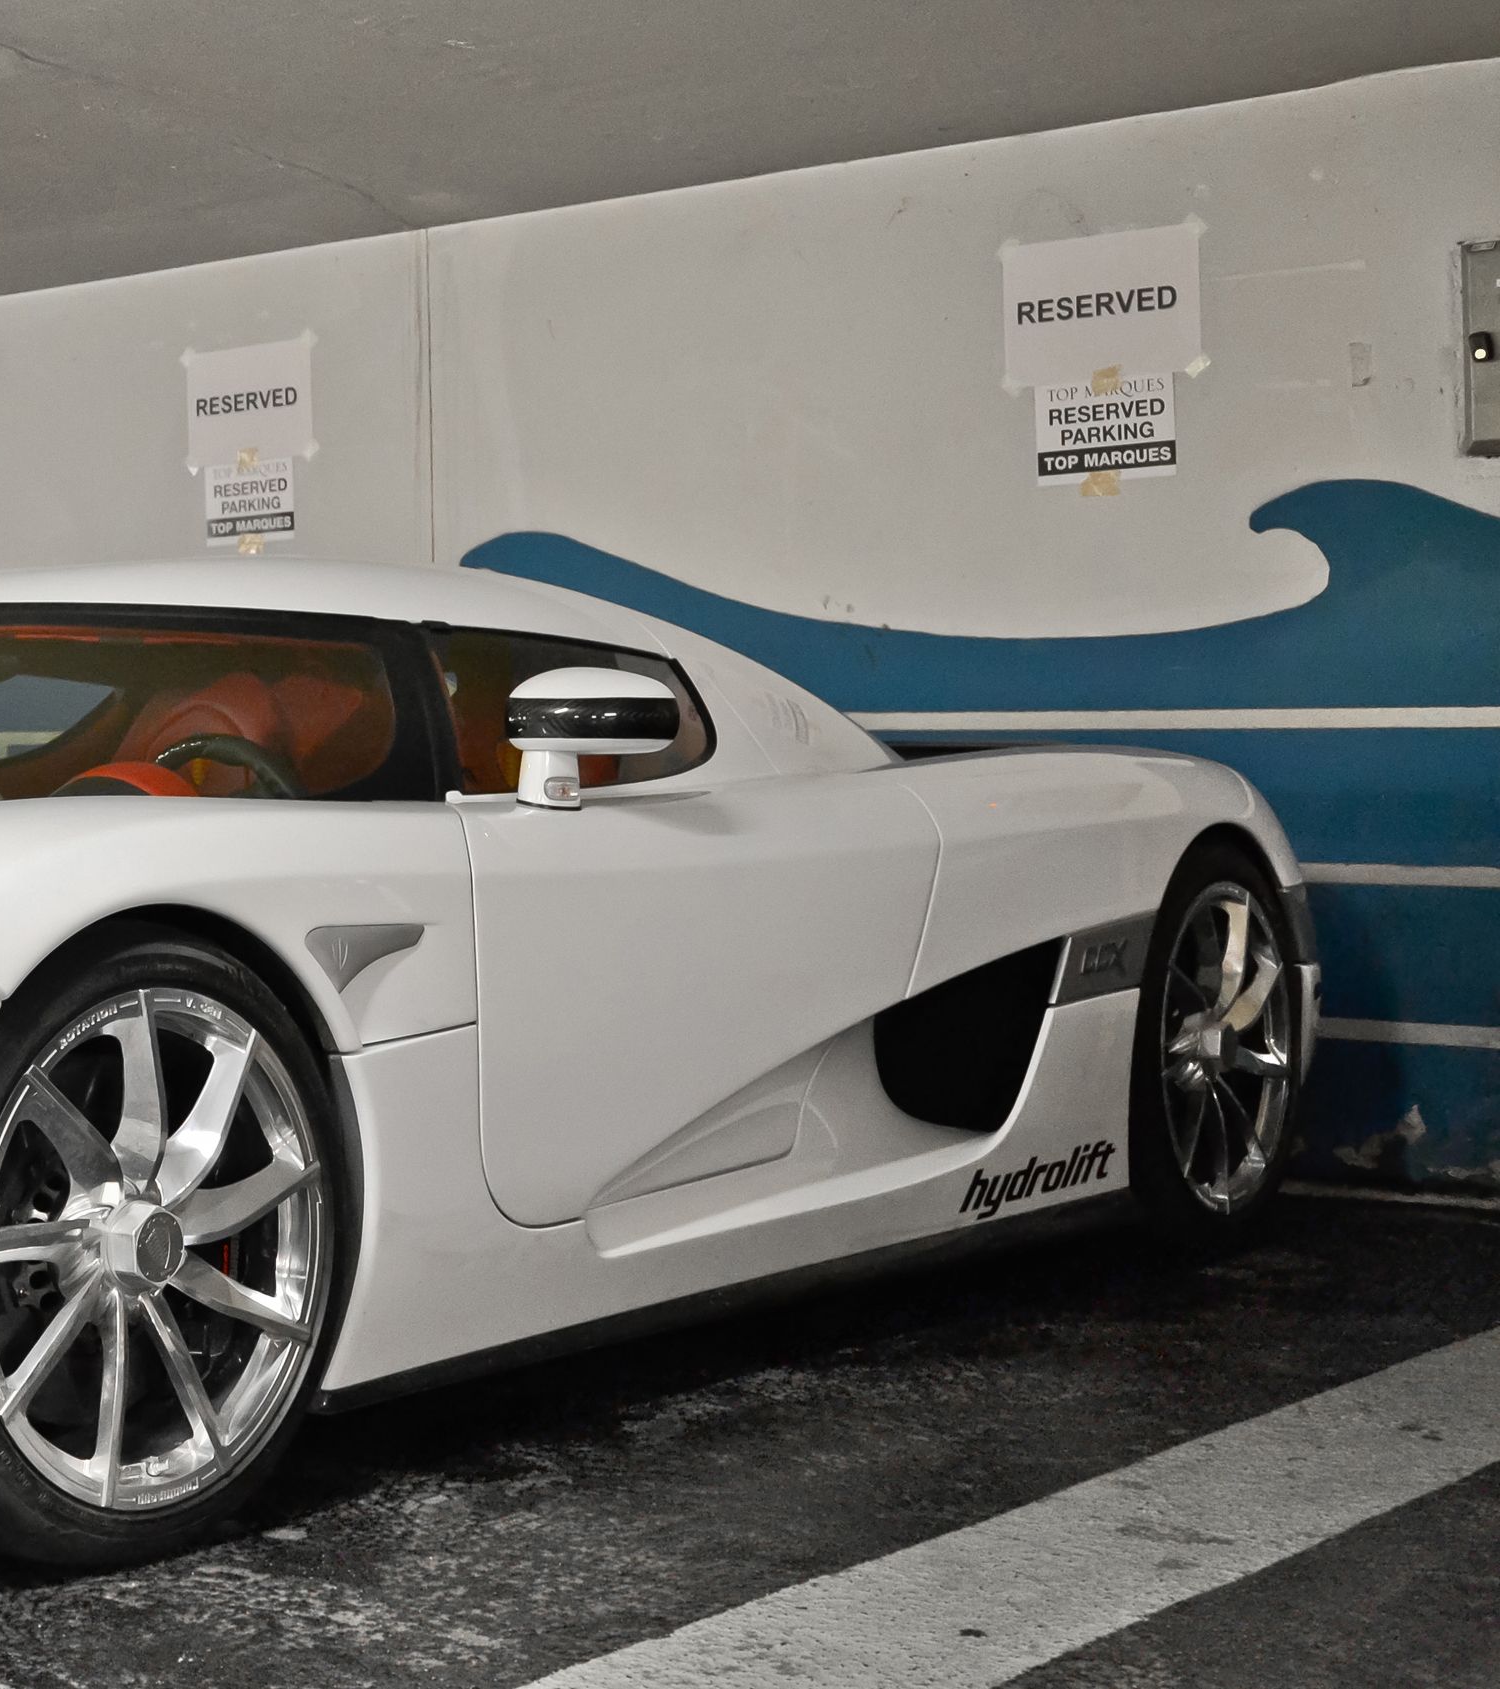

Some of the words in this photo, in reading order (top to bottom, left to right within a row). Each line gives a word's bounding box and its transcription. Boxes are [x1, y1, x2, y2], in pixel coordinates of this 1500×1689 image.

[1017, 284, 1178, 325] RESERVED
[196, 386, 297, 417] RESERVED
[1047, 386, 1078, 402] TOP
[1048, 397, 1165, 426] RESERVED
[1060, 421, 1155, 446] PARKING
[1044, 454, 1079, 471] TOP
[1084, 446, 1172, 468] MARQUES
[213, 477, 288, 498] RESERVED
[221, 495, 281, 514] PARKING
[211, 521, 234, 534] TOP
[235, 515, 292, 533] MARQUES
[59, 1003, 118, 1050] ROTATION
[959, 1140, 1116, 1220] hydrolift
